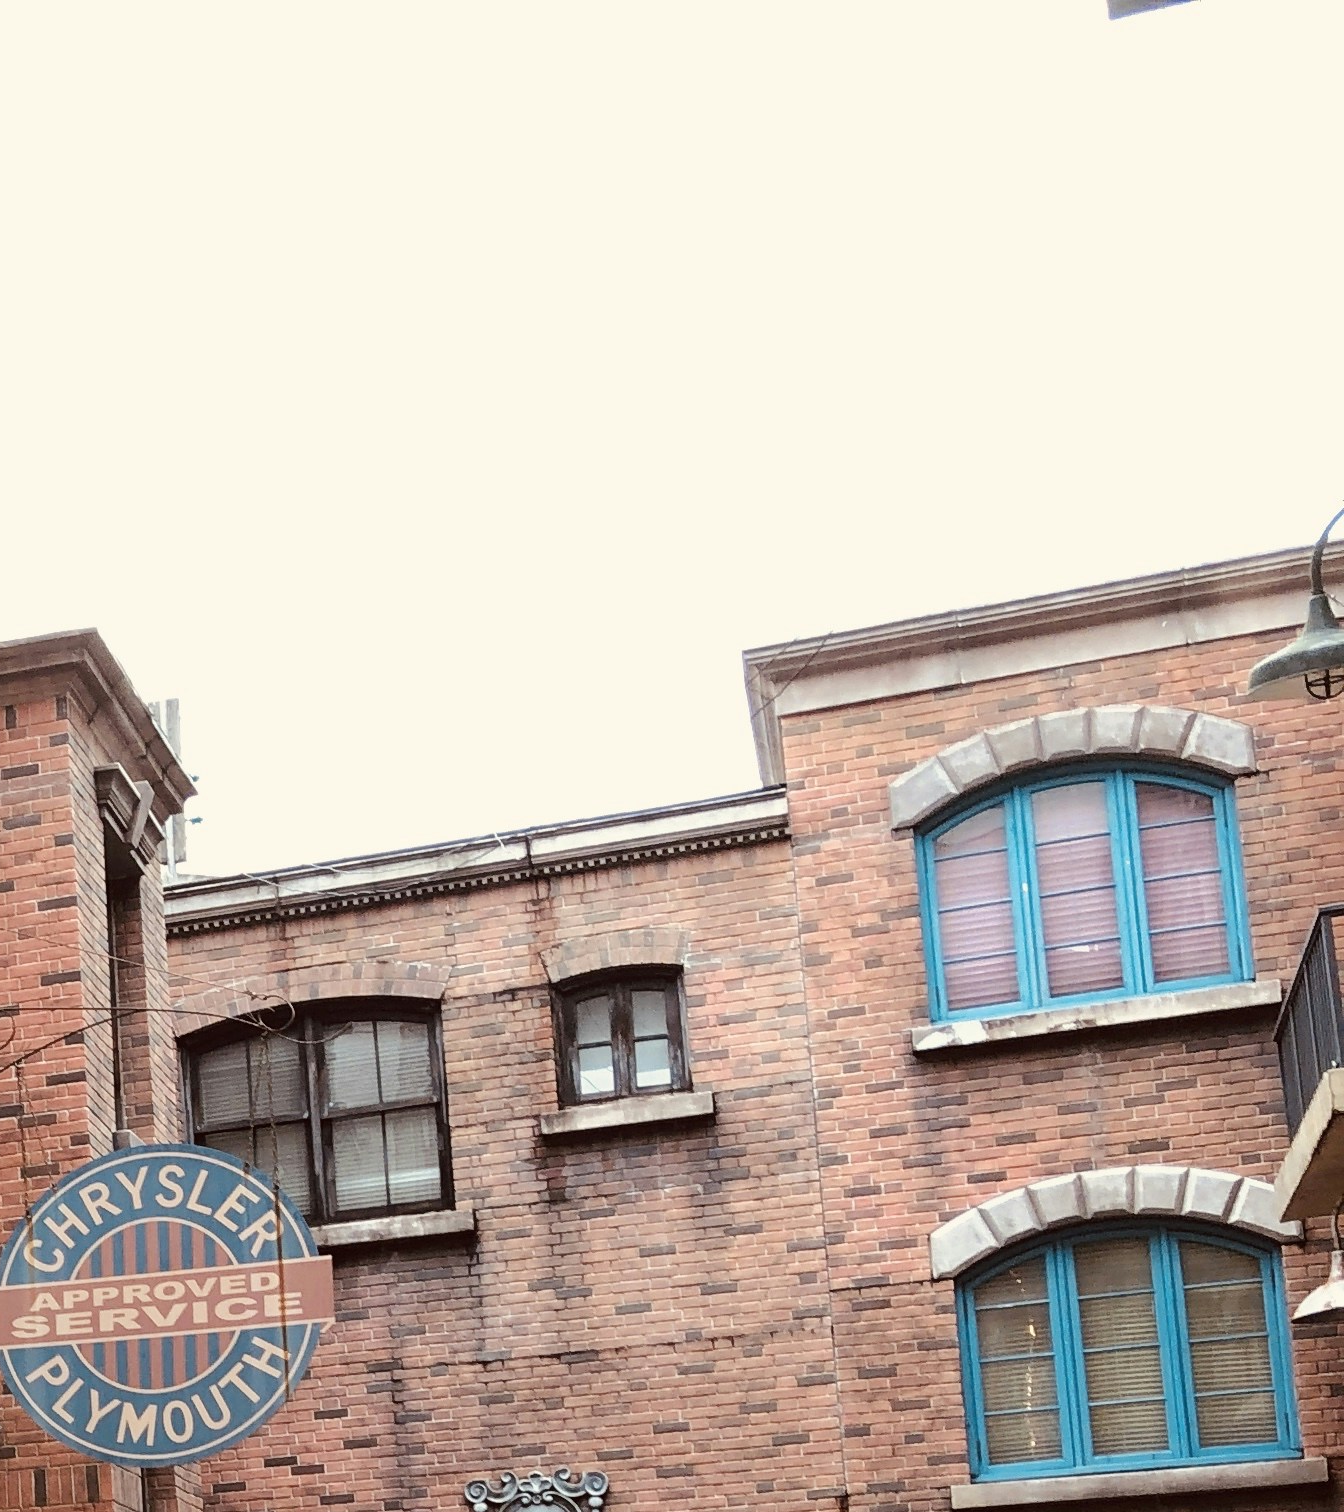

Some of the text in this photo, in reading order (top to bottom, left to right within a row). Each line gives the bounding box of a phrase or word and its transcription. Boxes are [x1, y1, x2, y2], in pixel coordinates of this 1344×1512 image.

[23, 1164, 285, 1274] CHRYSLER
[11, 1292, 304, 1340] SERVICE
[29, 1272, 280, 1313] APPROVED
[26, 1336, 292, 1447] PLYMOUTH
